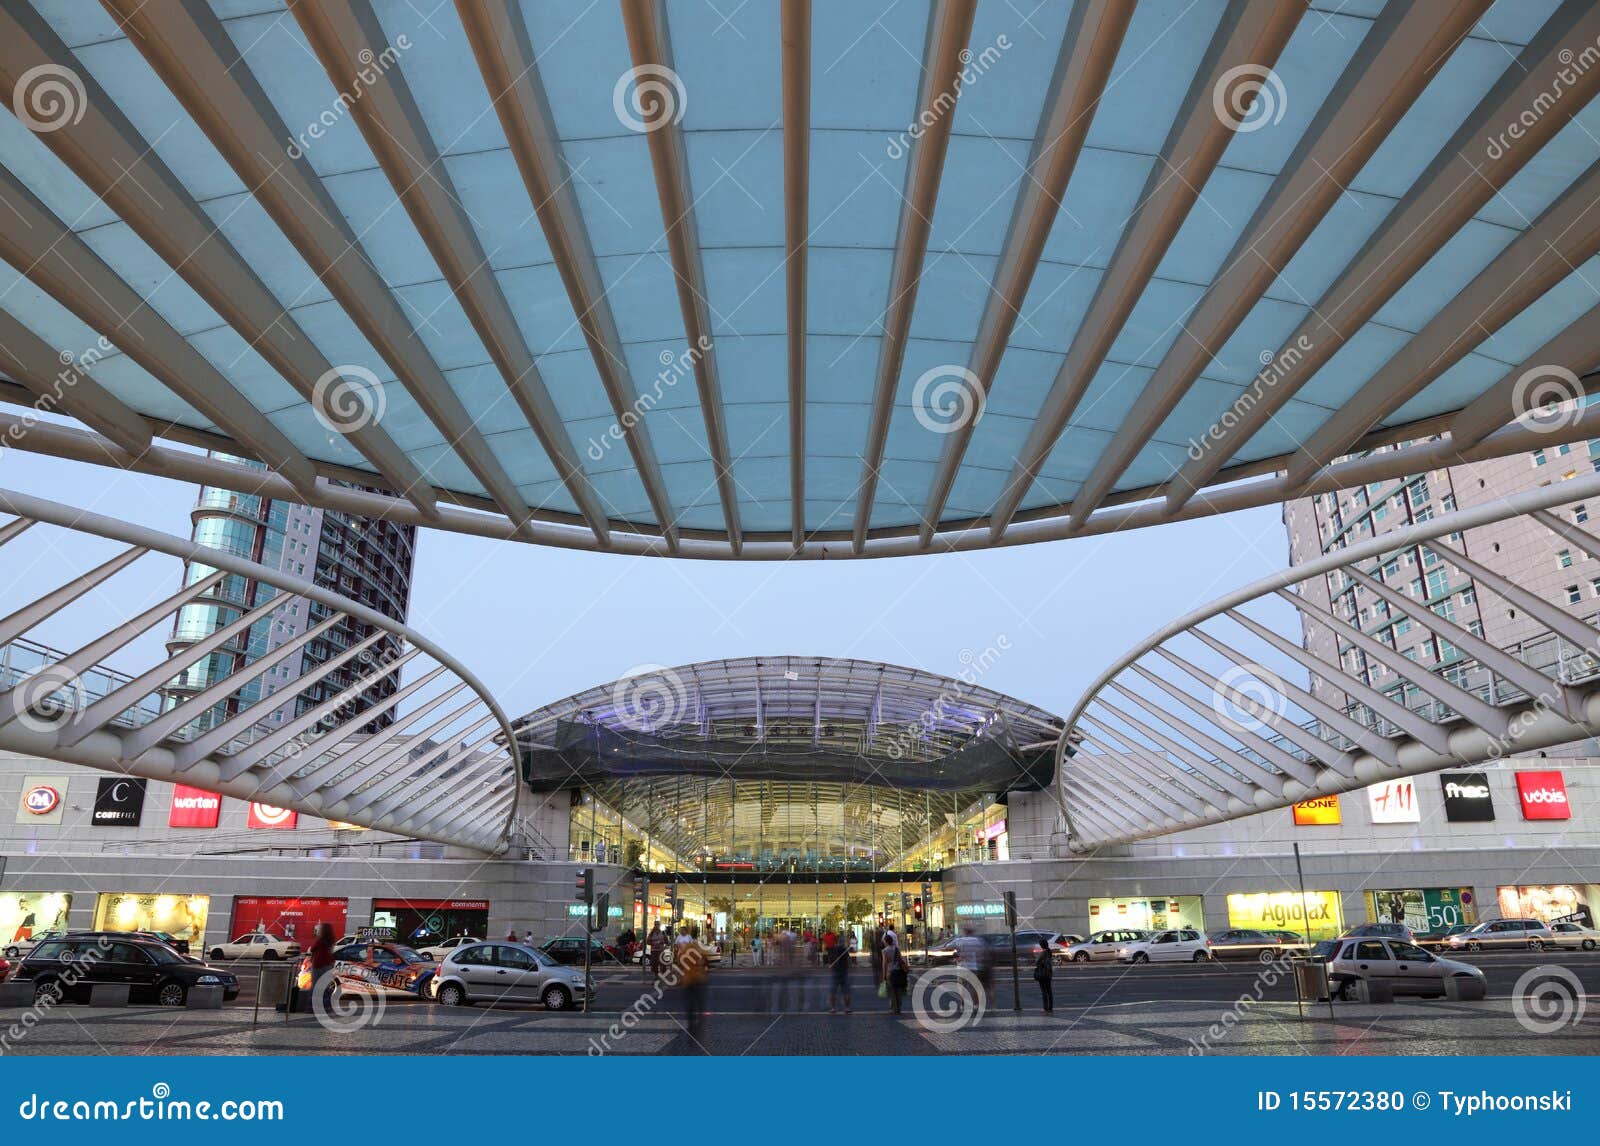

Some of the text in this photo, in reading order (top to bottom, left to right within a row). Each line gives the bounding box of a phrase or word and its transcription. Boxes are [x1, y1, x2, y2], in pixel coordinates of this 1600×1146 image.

[112, 782, 130, 802] C
[1374, 783, 1412, 813] HM
[1445, 782, 1490, 798] fnac
[174, 797, 218, 809] worten
[1297, 800, 1337, 809] ZONE
[1262, 903, 1330, 928] Agioax
[362, 926, 391, 937] GRATIS
[361, 964, 416, 991] ORIENTE
